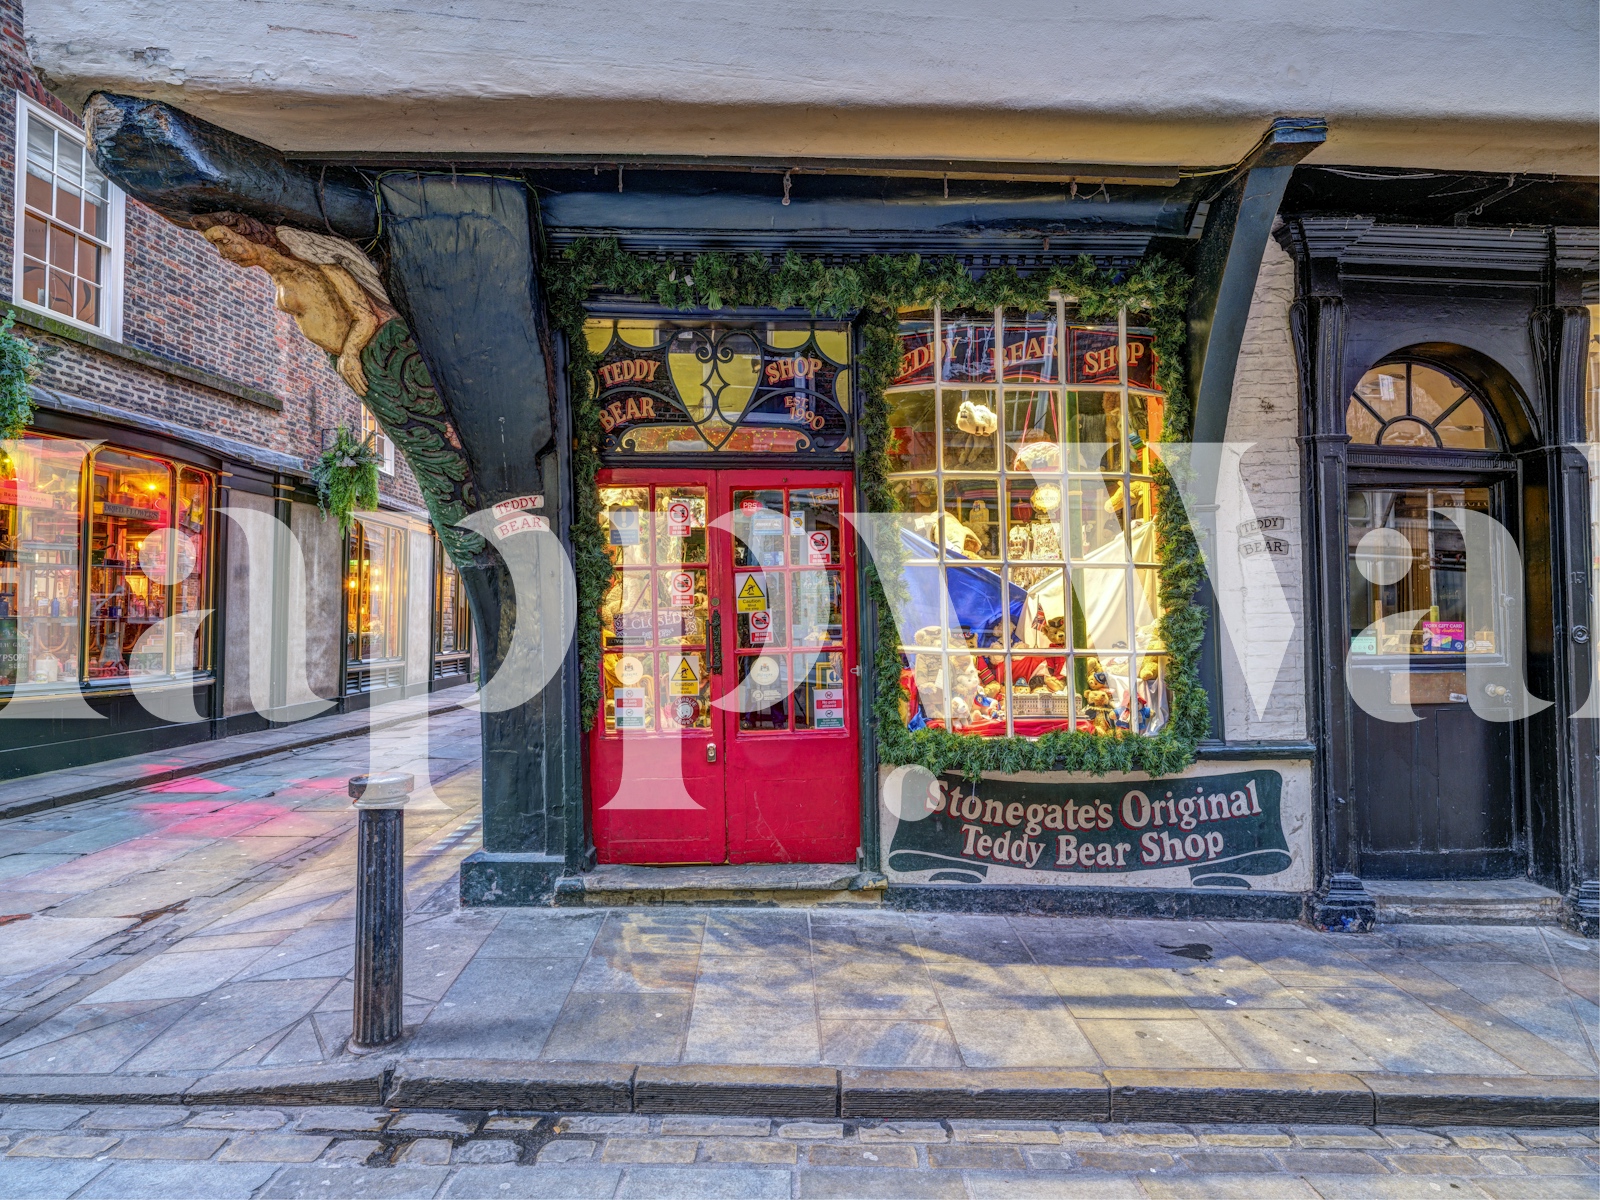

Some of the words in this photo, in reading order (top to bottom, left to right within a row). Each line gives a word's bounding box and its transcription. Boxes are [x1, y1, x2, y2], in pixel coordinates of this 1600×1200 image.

[898, 336, 962, 378] EDDY
[988, 335, 1059, 371] BEAR
[1083, 342, 1145, 375] SHOP
[598, 359, 660, 387] TEDDY
[765, 356, 823, 386] SHOP
[599, 397, 656, 433] BEAR
[790, 406, 825, 430] 1990
[126, 507, 159, 520] FLOWERS
[495, 496, 538, 515] TEDDY
[499, 516, 541, 536] BEAR
[1241, 517, 1278, 533] TEDDY
[1243, 541, 1283, 555] BEAR
[925, 780, 1114, 836] Stonegate's
[1119, 780, 1262, 832] Original
[961, 824, 1046, 869] Teddy
[1054, 830, 1131, 868] Bear
[1139, 831, 1224, 865] Shop
